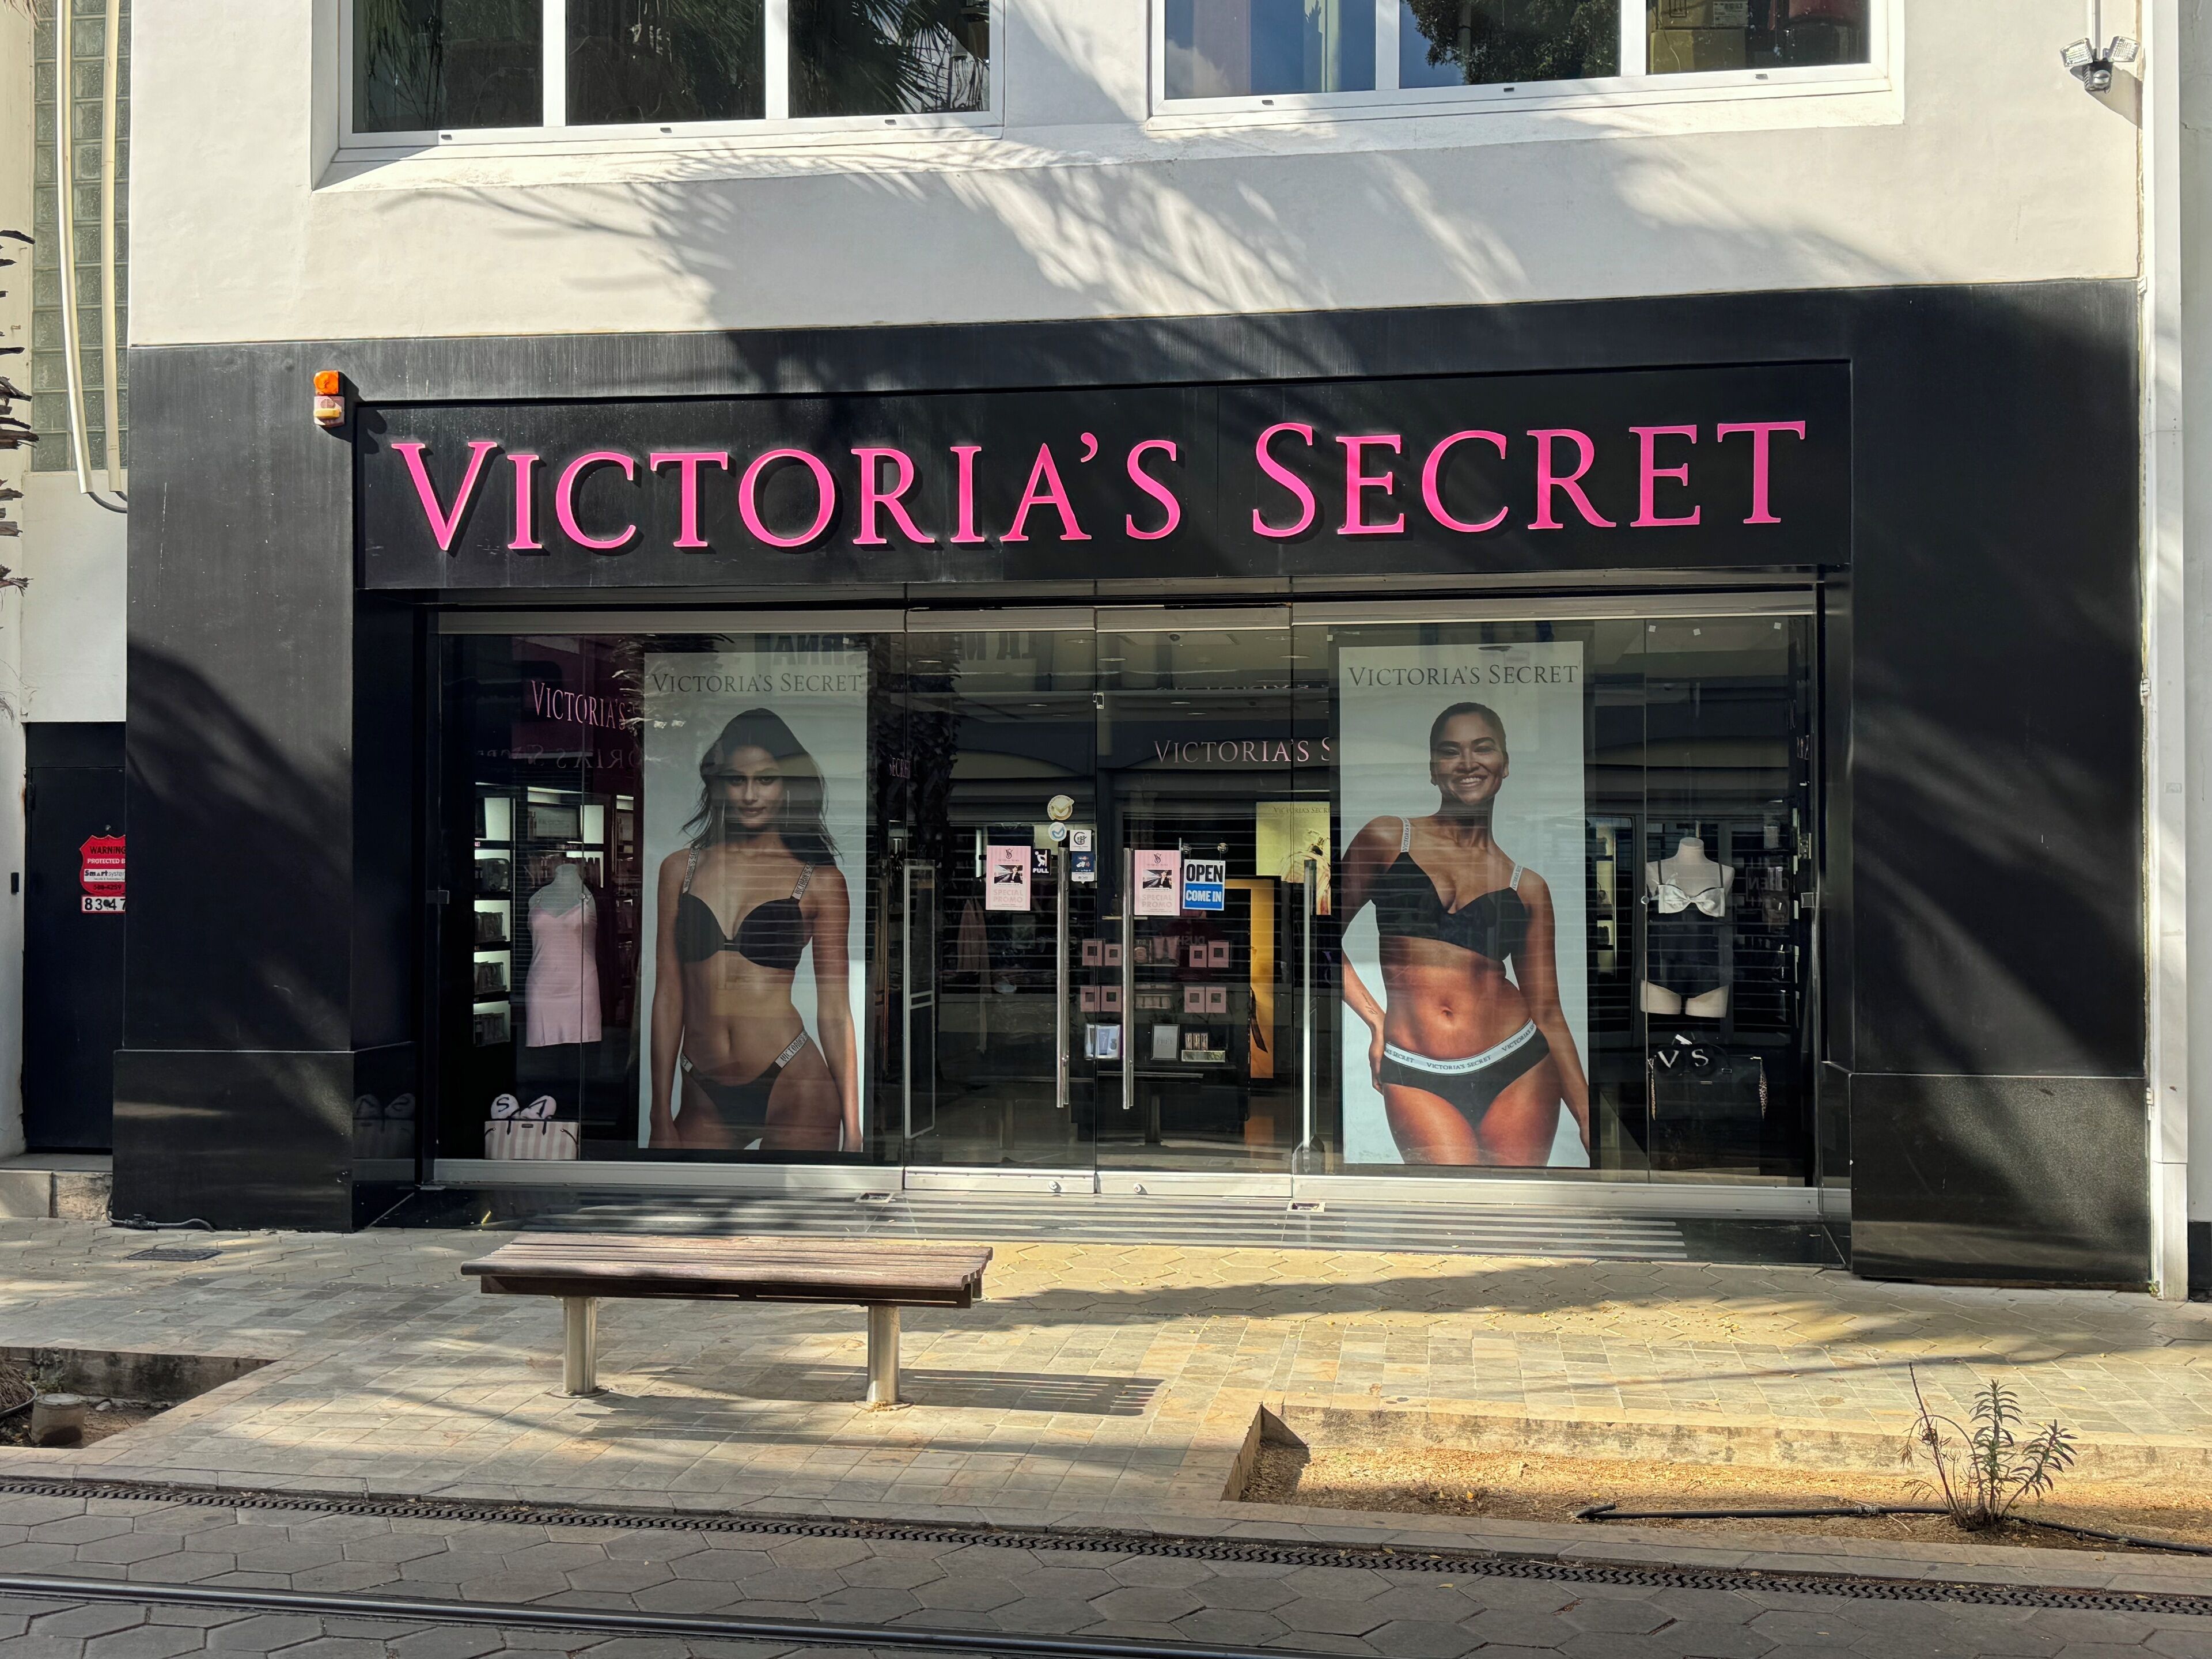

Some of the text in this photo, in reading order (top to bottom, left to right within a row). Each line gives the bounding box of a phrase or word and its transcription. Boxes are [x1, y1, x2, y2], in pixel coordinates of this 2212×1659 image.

[391, 421, 1806, 551] VICTORIA'S SECRET
[652, 673, 862, 692] VICTORIA'S SECRET
[1349, 664, 1578, 685] VICTORIA'S SECRET
[532, 680, 626, 730] VICTORIA'S
[1154, 738, 1309, 763] VICTORIA'S
[1186, 863, 1224, 882] OPEN
[1186, 890, 1222, 903] COME IN
[1392, 1051, 1415, 1063] SECRET
[1467, 1055, 1491, 1068] SECRET
